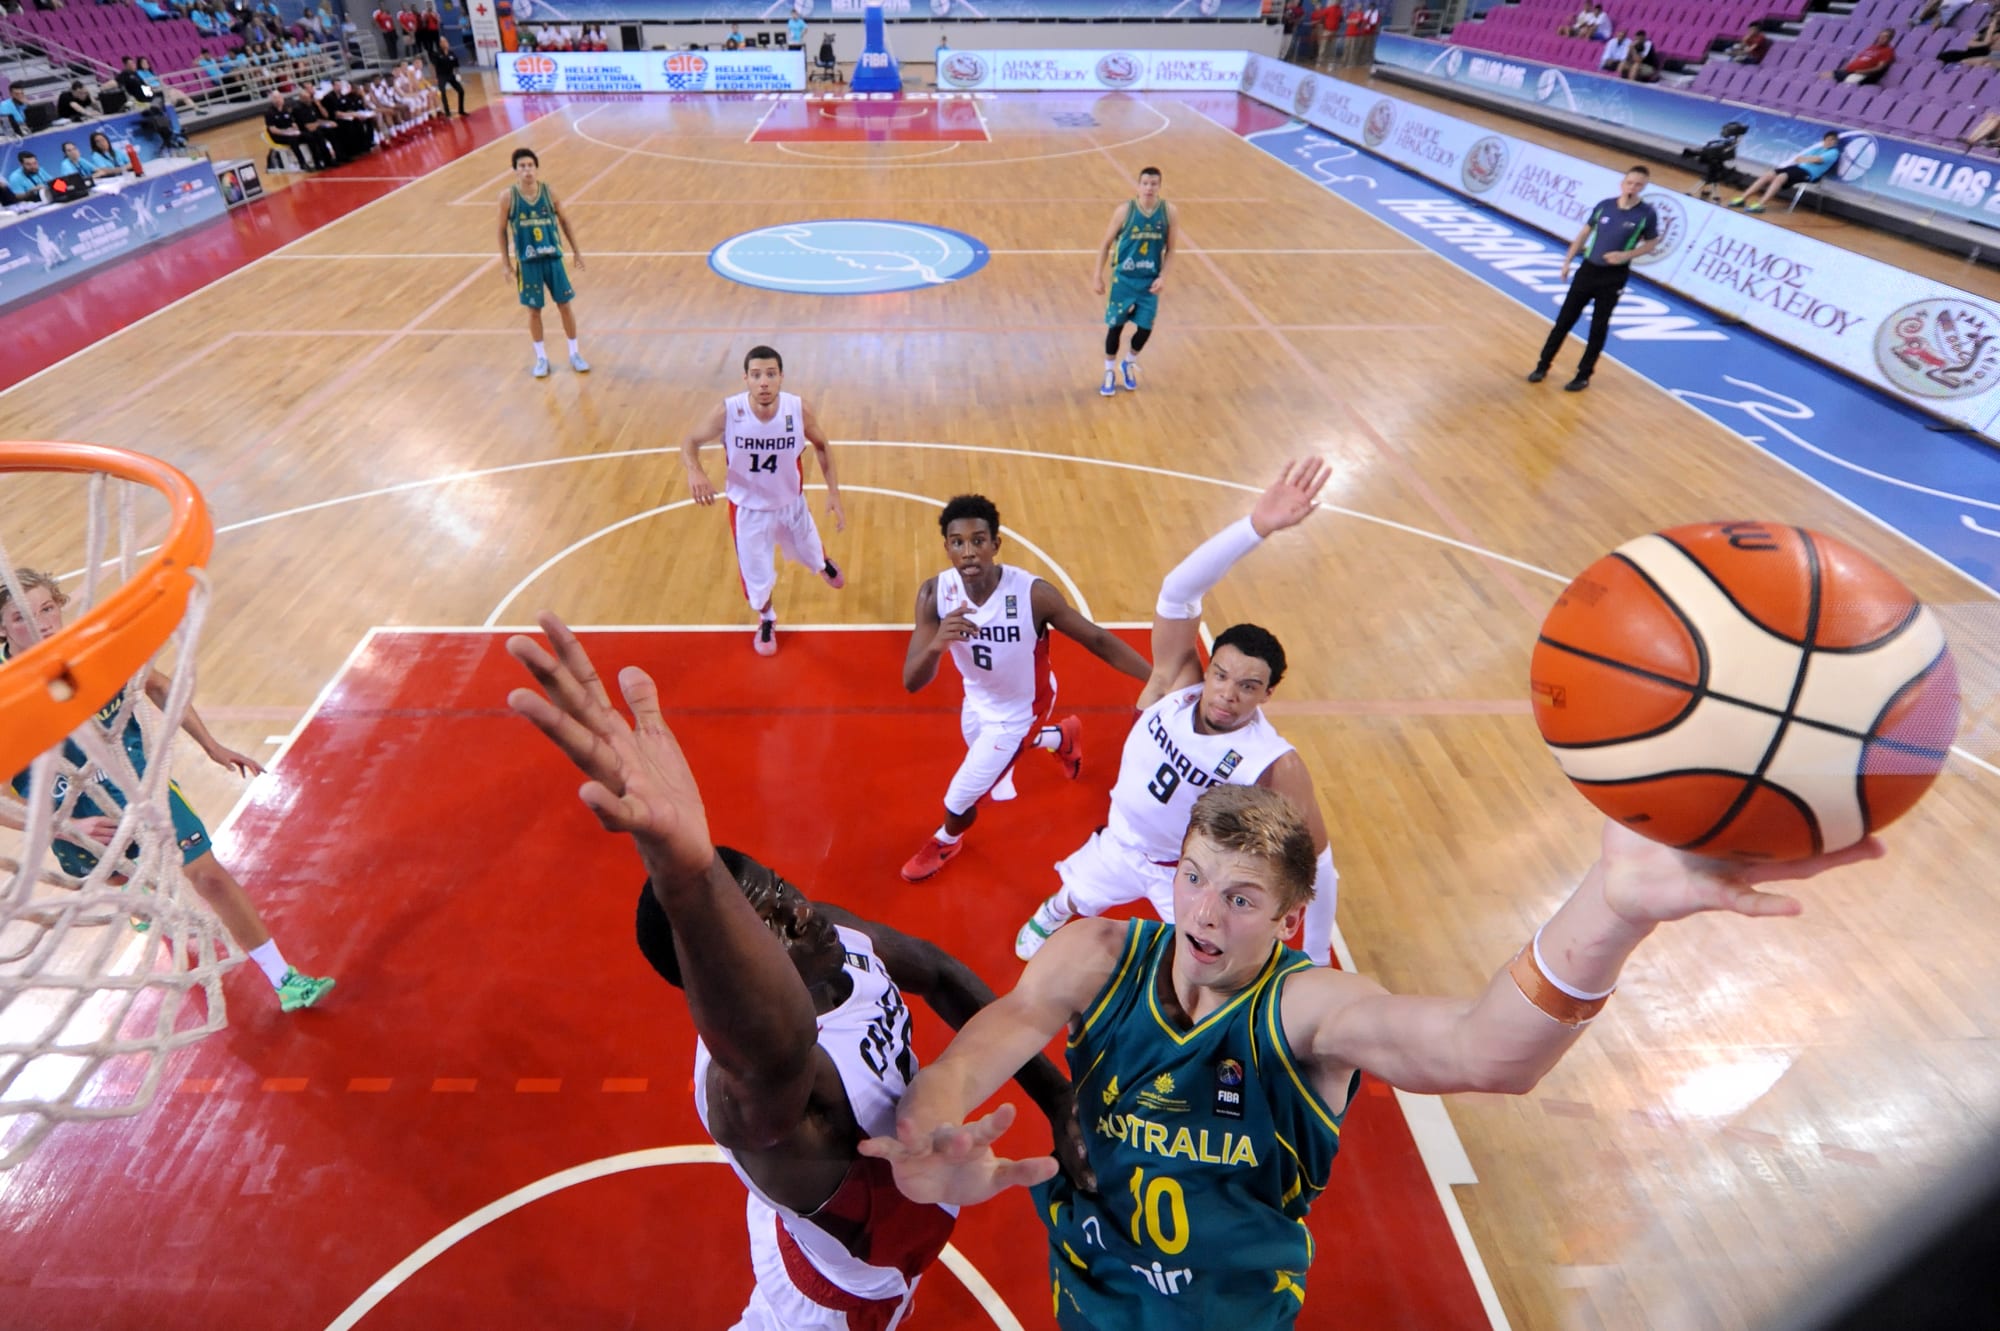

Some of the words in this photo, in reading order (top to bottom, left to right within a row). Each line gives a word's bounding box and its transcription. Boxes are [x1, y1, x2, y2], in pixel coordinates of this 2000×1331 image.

[715, 65, 772, 73] HELLENIC
[863, 53, 888, 67] FIBA
[566, 82, 642, 90] FEDERATION
[715, 73, 785, 81] BASKETBALL
[716, 81, 792, 89] FEDERATION
[1519, 164, 1583, 199] ΔΗΜΟΣ
[1887, 152, 1992, 207] HELLAS
[1508, 179, 1594, 221] ΗΡΑΚΛΕΙ
[1702, 235, 1814, 289] ΔΗΜΟΣ
[1691, 254, 1866, 335] ΗΡΑΚΛΕΙΟΥ
[735, 436, 796, 450] CANADA
[749, 453, 778, 474] 14
[971, 644, 993, 671] 6
[1147, 762, 1181, 805] 9
[1218, 1090, 1240, 1104] FIBA
[1096, 1113, 1259, 1168] AUTRALIA
[1129, 1166, 1190, 1256] 10
